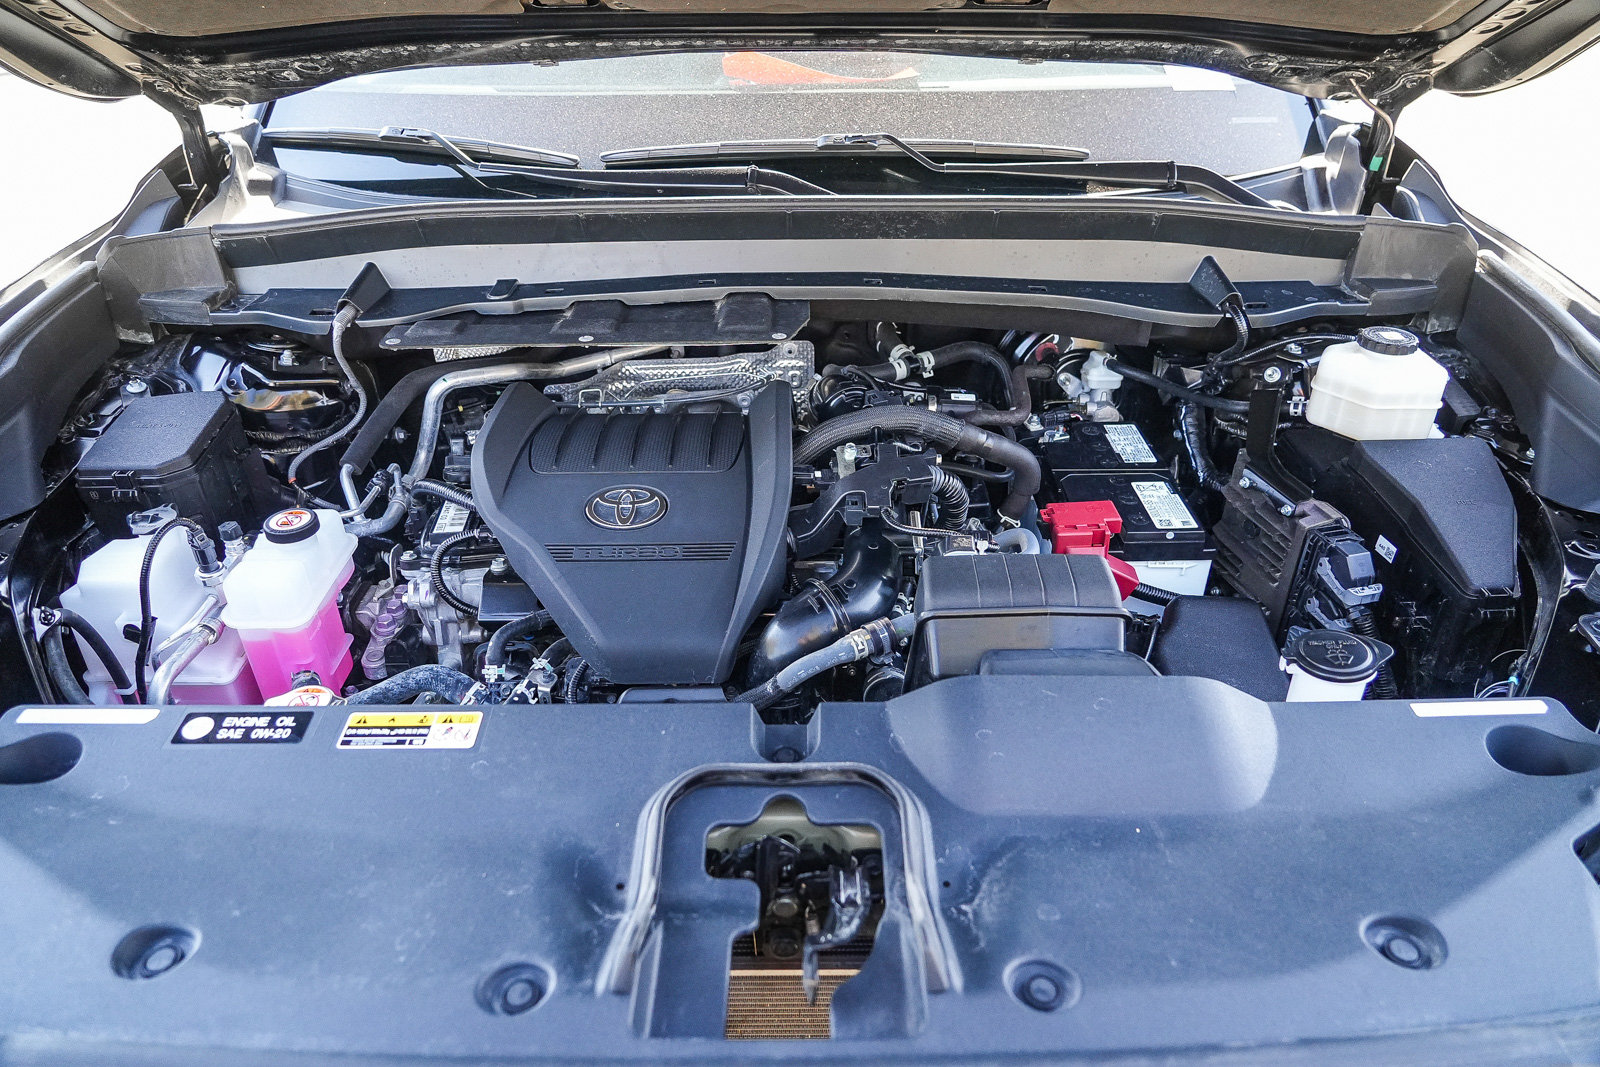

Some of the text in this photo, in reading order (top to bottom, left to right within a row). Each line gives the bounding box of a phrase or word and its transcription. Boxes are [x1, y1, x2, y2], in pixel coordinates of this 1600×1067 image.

[575, 546, 681, 559] TURBO
[222, 716, 297, 727] ENGINE OIL
[216, 728, 292, 739] SAE 0W-20
